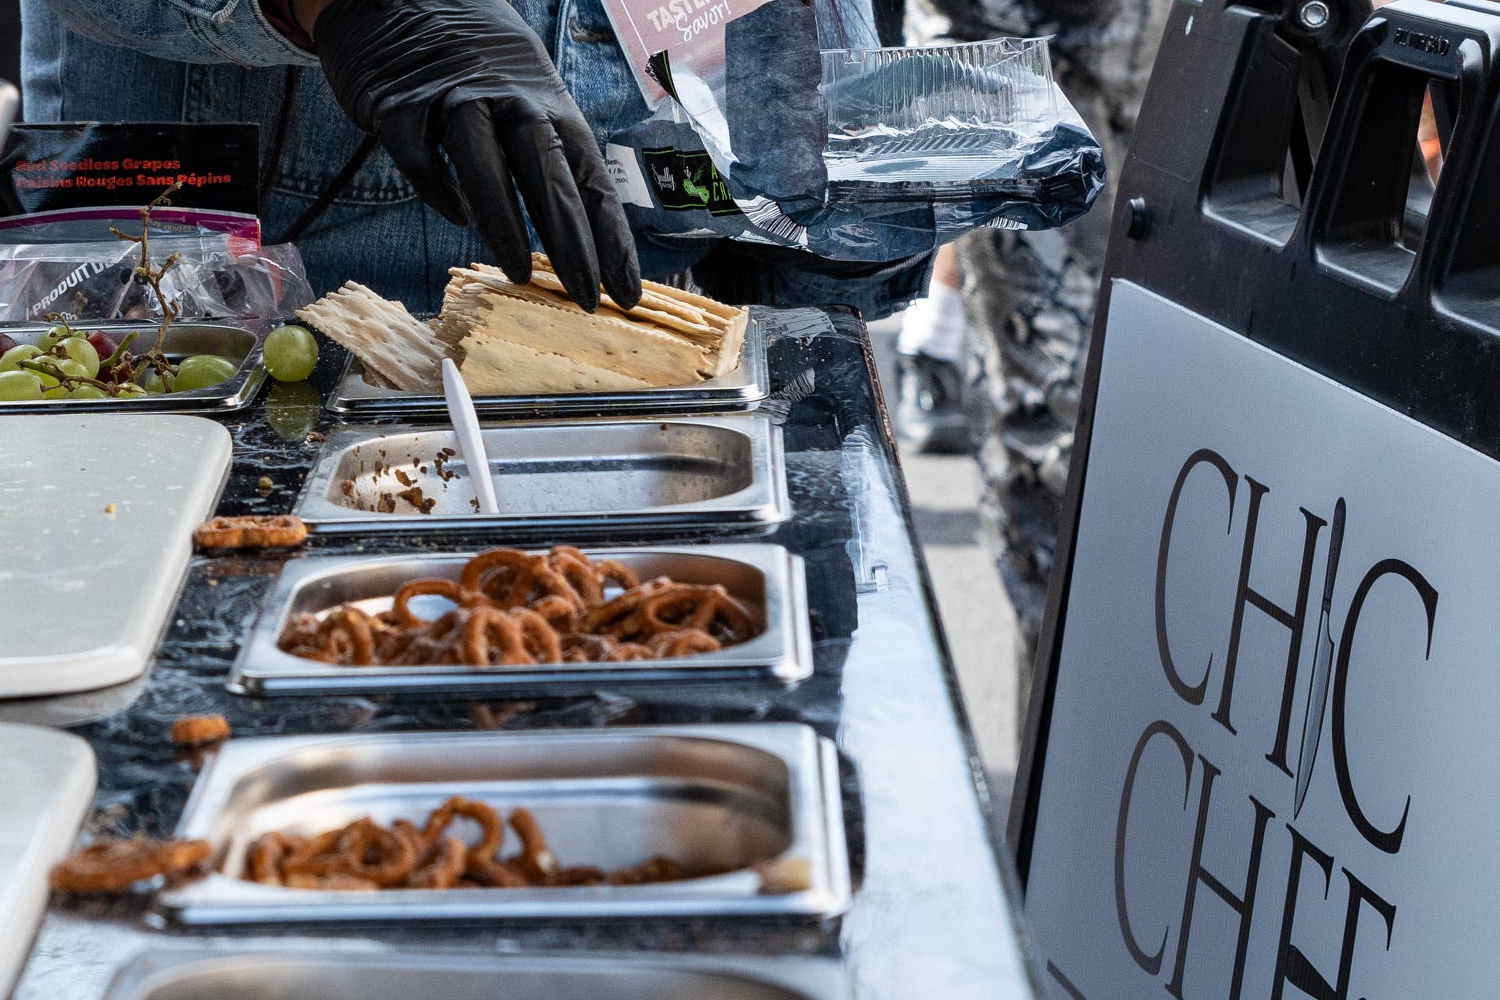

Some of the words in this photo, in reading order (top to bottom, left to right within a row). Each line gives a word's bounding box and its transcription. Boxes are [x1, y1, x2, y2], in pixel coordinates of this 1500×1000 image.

[50, 158, 120, 171] Seedless
[121, 158, 181, 172] Grapes
[75, 175, 134, 190] Rouges
[136, 174, 175, 187] Sans
[176, 172, 232, 187] Pépins
[32, 262, 91, 317] PRODUIT
